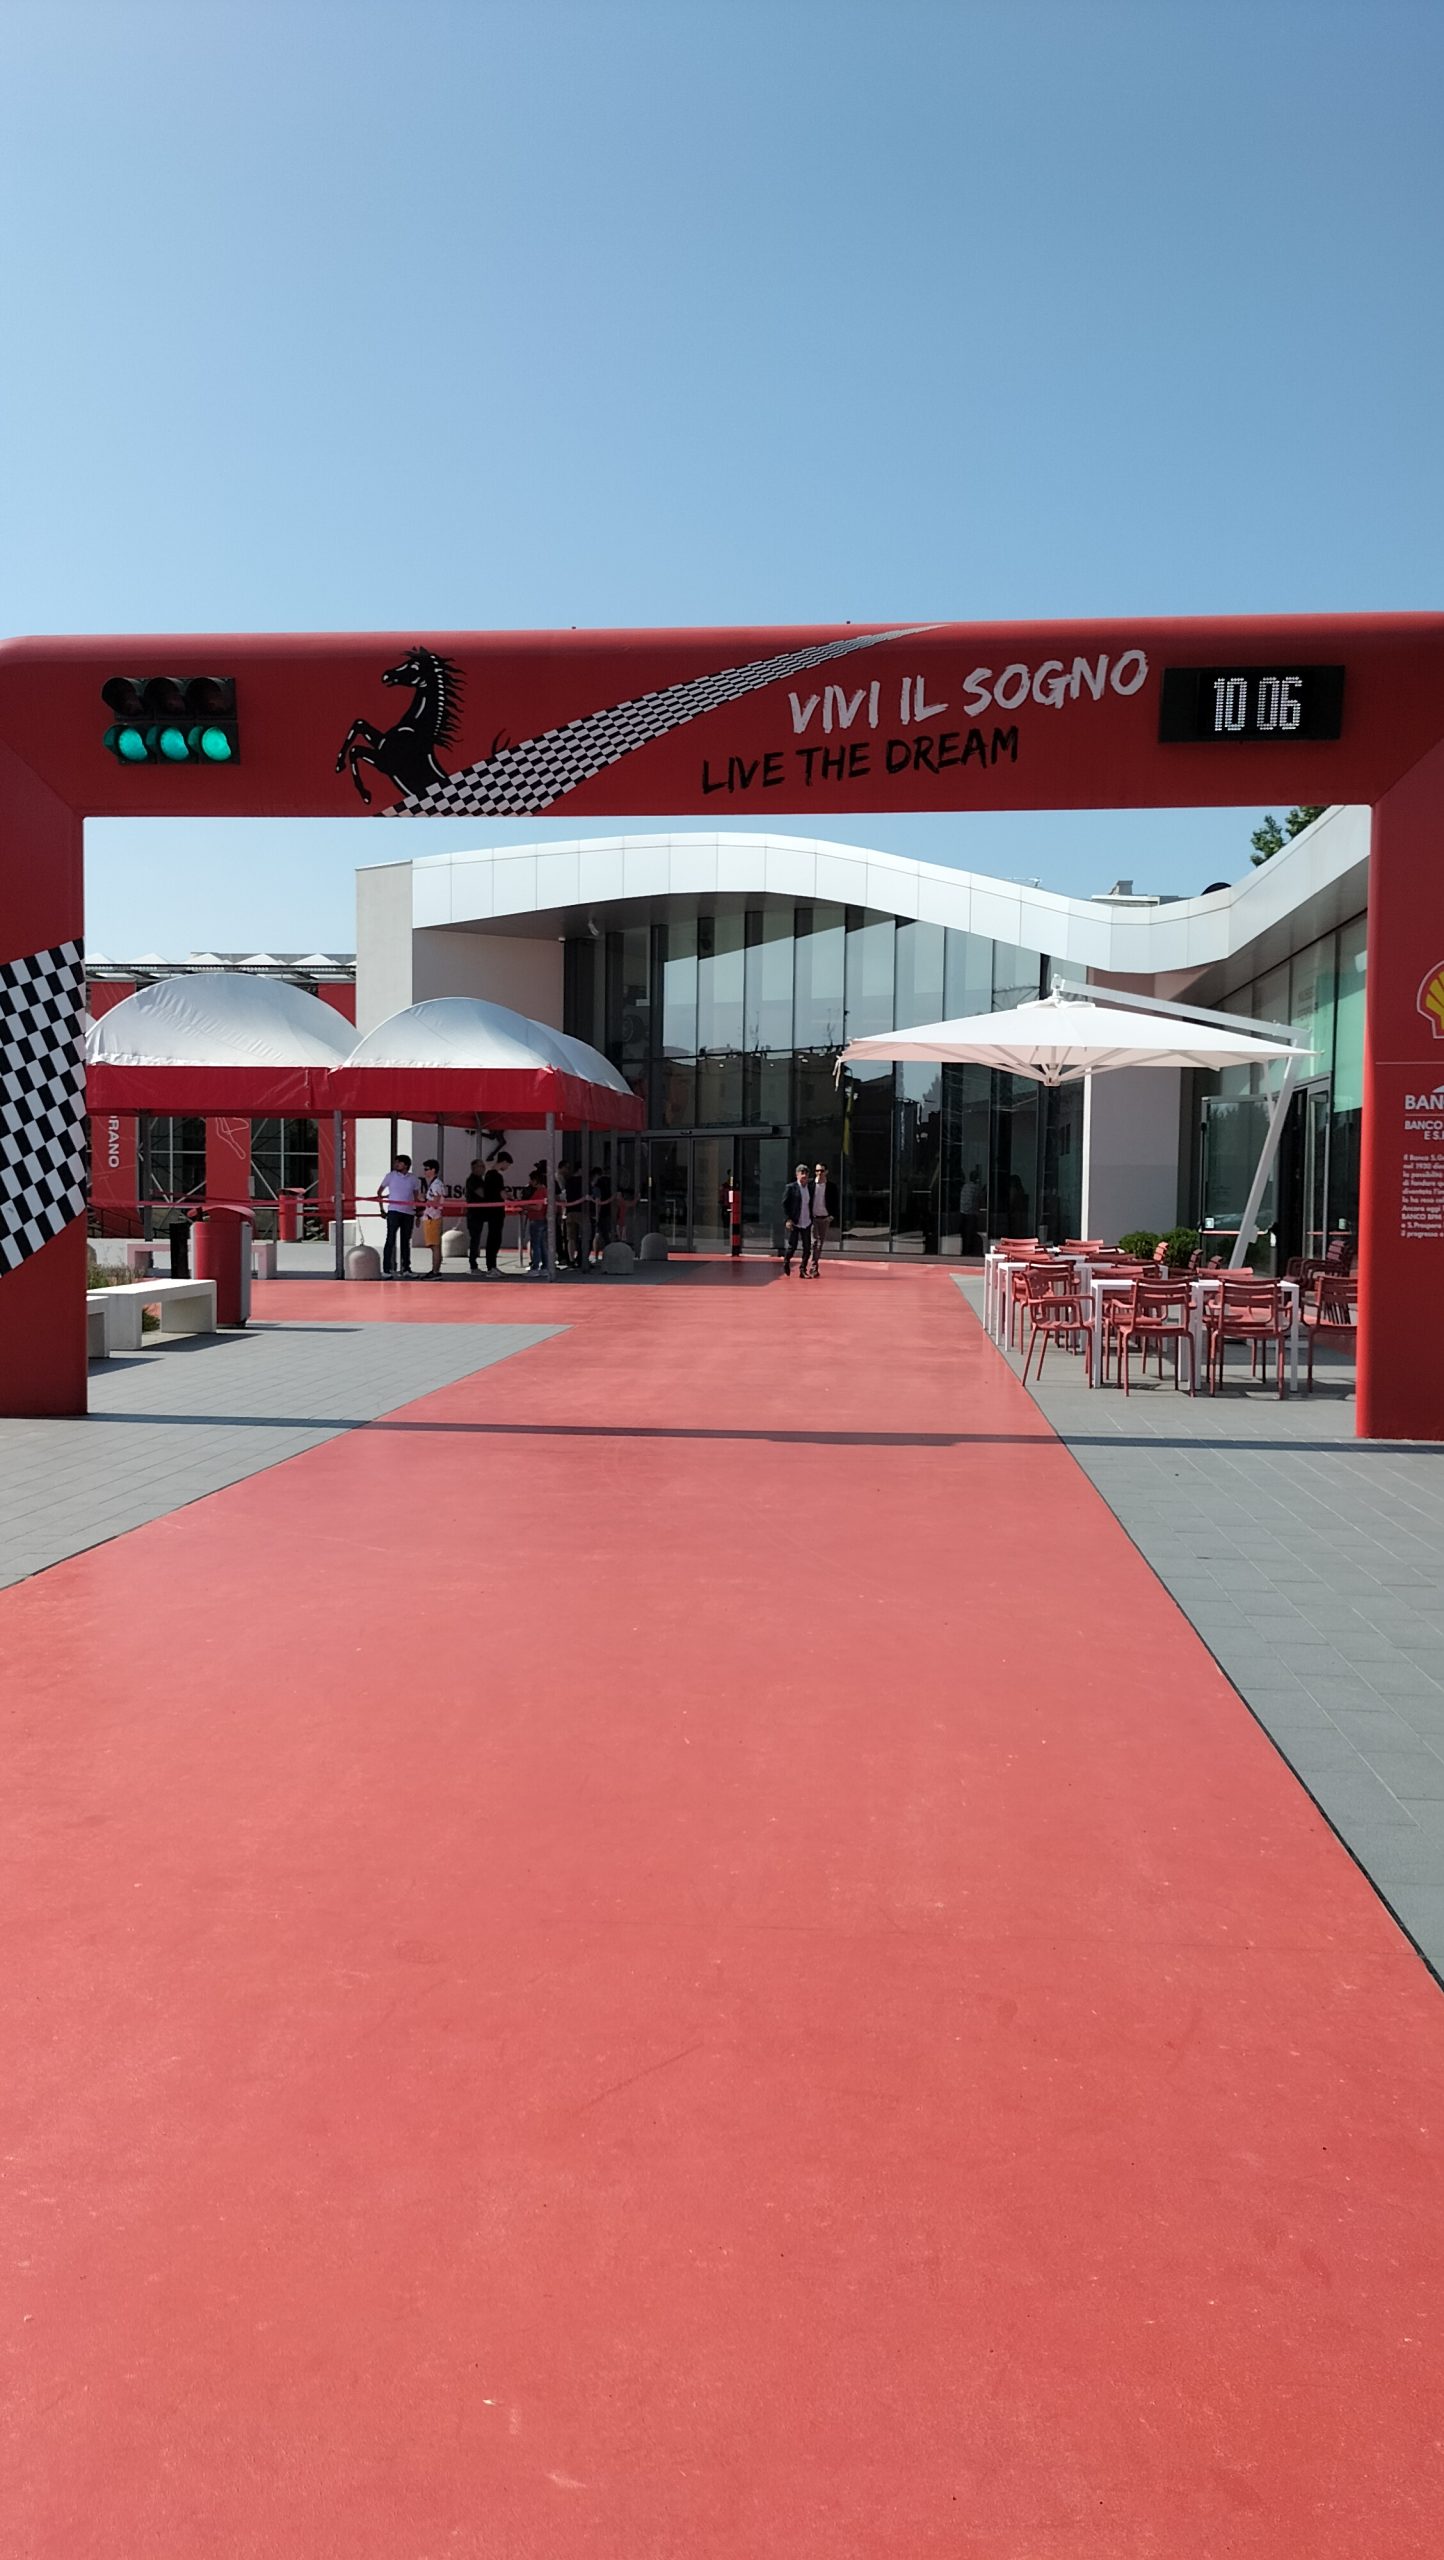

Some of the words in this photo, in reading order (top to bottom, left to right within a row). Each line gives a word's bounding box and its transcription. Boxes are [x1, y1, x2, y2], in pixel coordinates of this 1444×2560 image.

[788, 681, 880, 733] VIVI
[900, 675, 949, 725] IL
[963, 649, 1149, 717] SOGNO
[1214, 677, 1247, 731] 10
[1257, 677, 1302, 730] 06
[702, 752, 785, 794] LIVE
[796, 742, 871, 786] THE
[885, 725, 1019, 774] DREAM
[1404, 1094, 1444, 1110] BAN
[1404, 1120, 1443, 1130] BANCO
